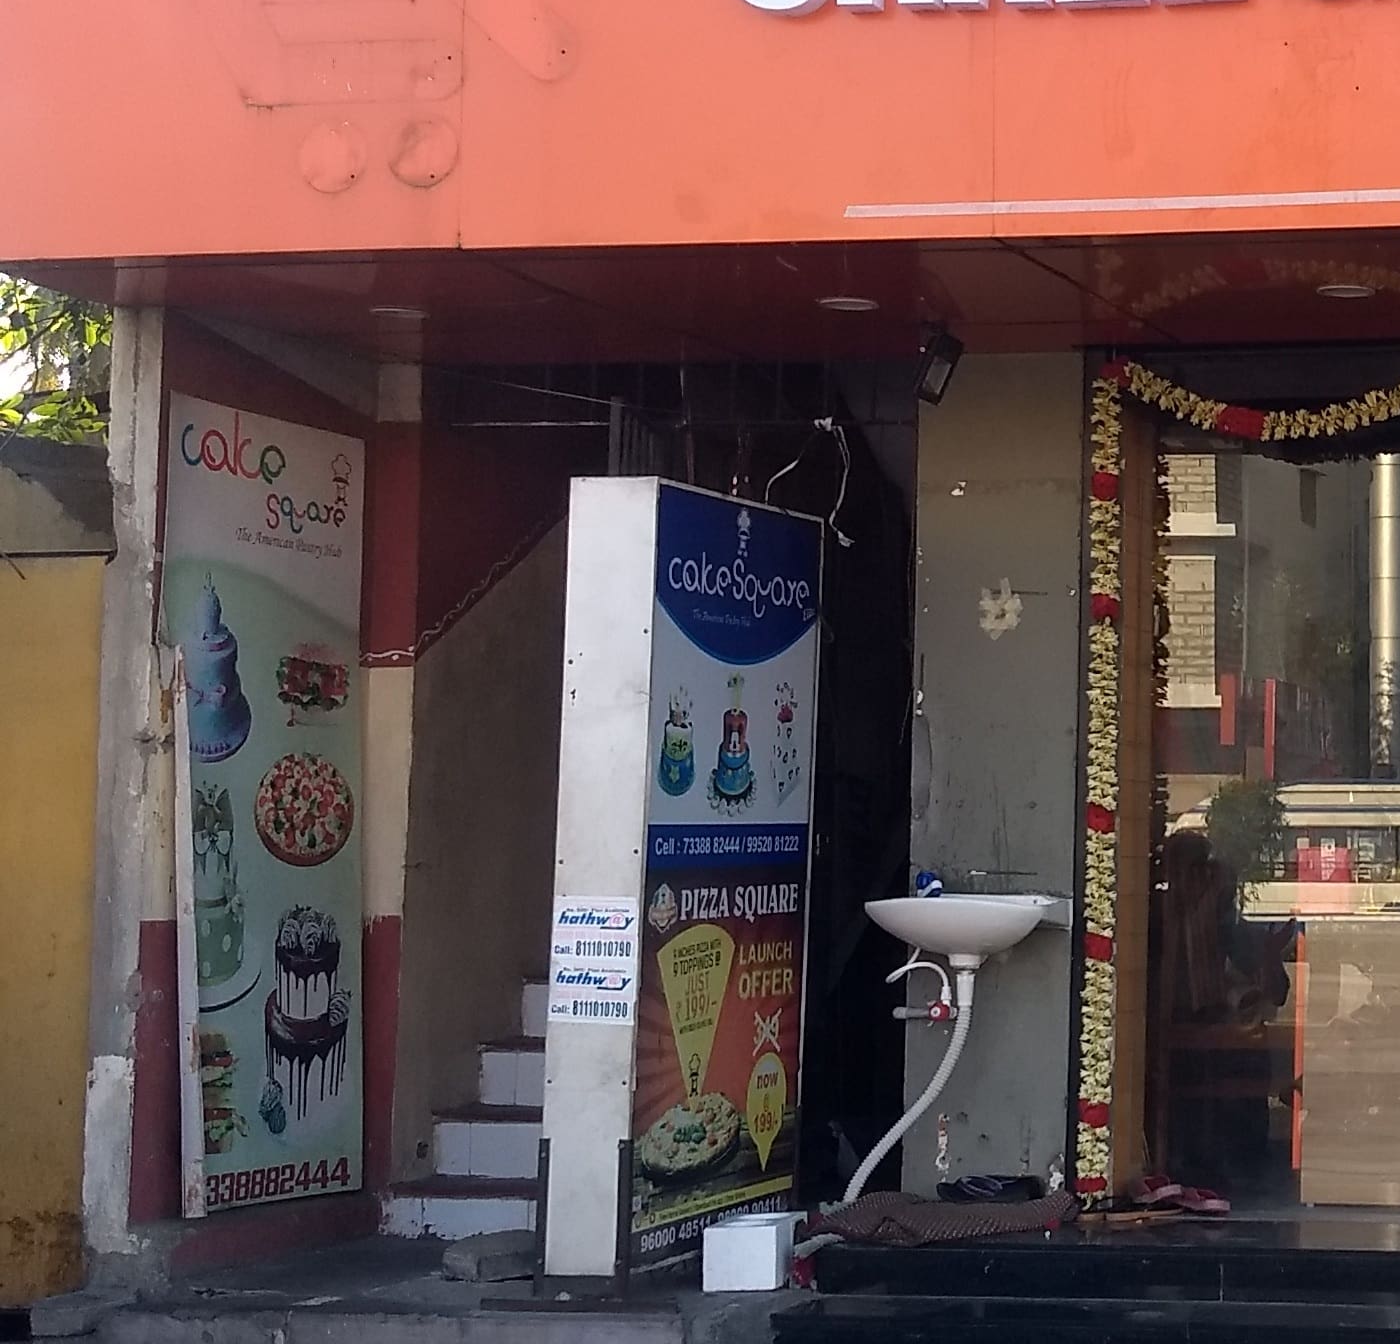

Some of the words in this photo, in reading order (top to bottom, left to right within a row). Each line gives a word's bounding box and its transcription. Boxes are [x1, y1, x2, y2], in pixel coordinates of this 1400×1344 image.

[181, 411, 286, 485] cake
[266, 493, 346, 534] square
[680, 886, 730, 921] PIZZA
[733, 883, 799, 923] SQUARE
[575, 940, 631, 958] 8111010790
[738, 940, 793, 966] LAUNCH
[737, 968, 794, 1000] OFFER
[572, 1000, 628, 1018] 8111010790
[756, 1070, 779, 1089] now
